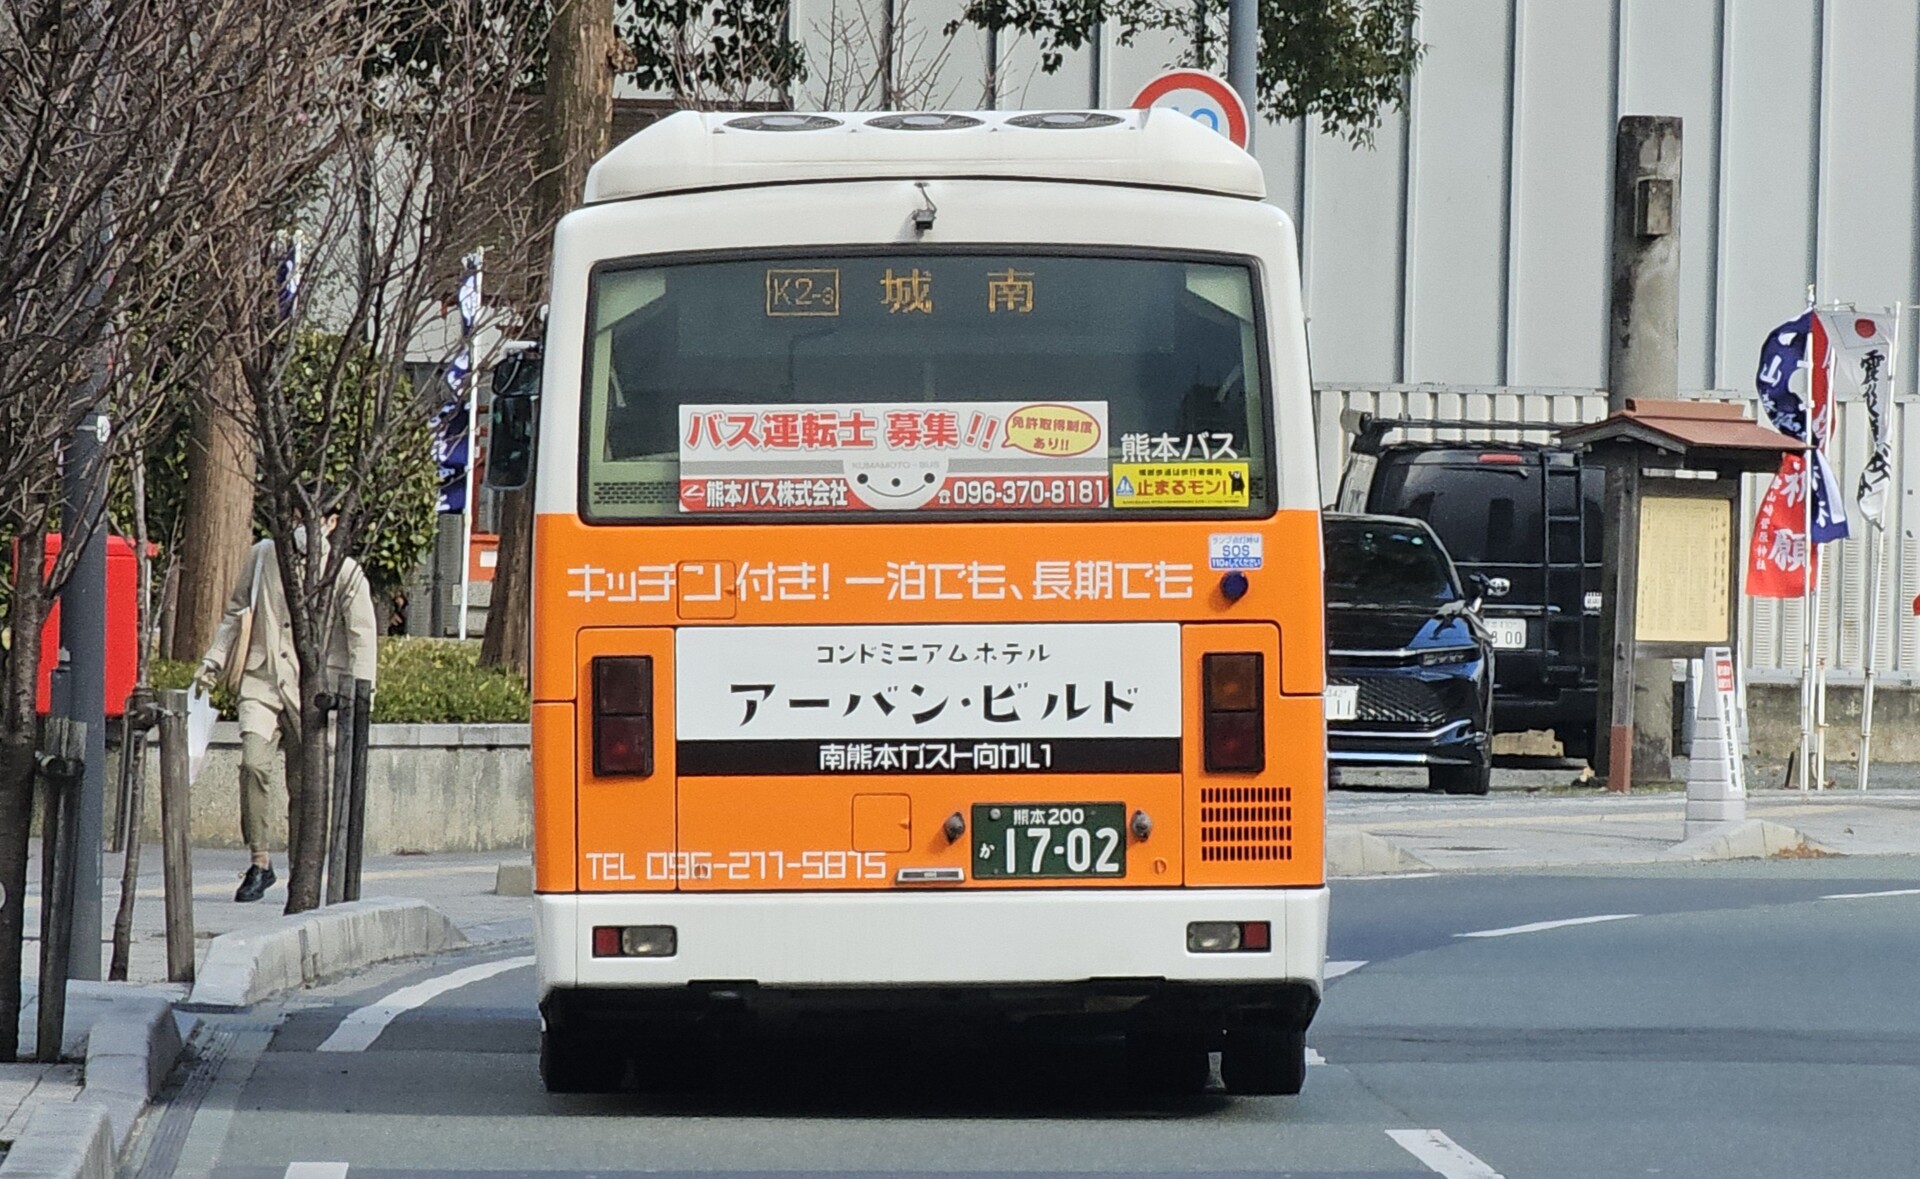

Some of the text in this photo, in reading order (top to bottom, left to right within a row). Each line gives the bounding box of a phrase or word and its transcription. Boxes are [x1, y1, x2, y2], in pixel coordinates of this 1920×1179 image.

[773, 278, 834, 305] K2-3
[687, 411, 876, 448] バス運転士
[1120, 431, 1238, 463] 熊本バス
[706, 480, 848, 508] 熊本バス株式会社
[953, 480, 1104, 505] 096-370-8181
[1136, 480, 1227, 496] 止まるモン!
[1222, 545, 1250, 557] SOS
[817, 643, 1051, 664] コンドミニアムホテル
[730, 680, 1139, 727] アーバン・ビルド
[979, 828, 1119, 873] か 17-02
[586, 853, 635, 880] TEL
